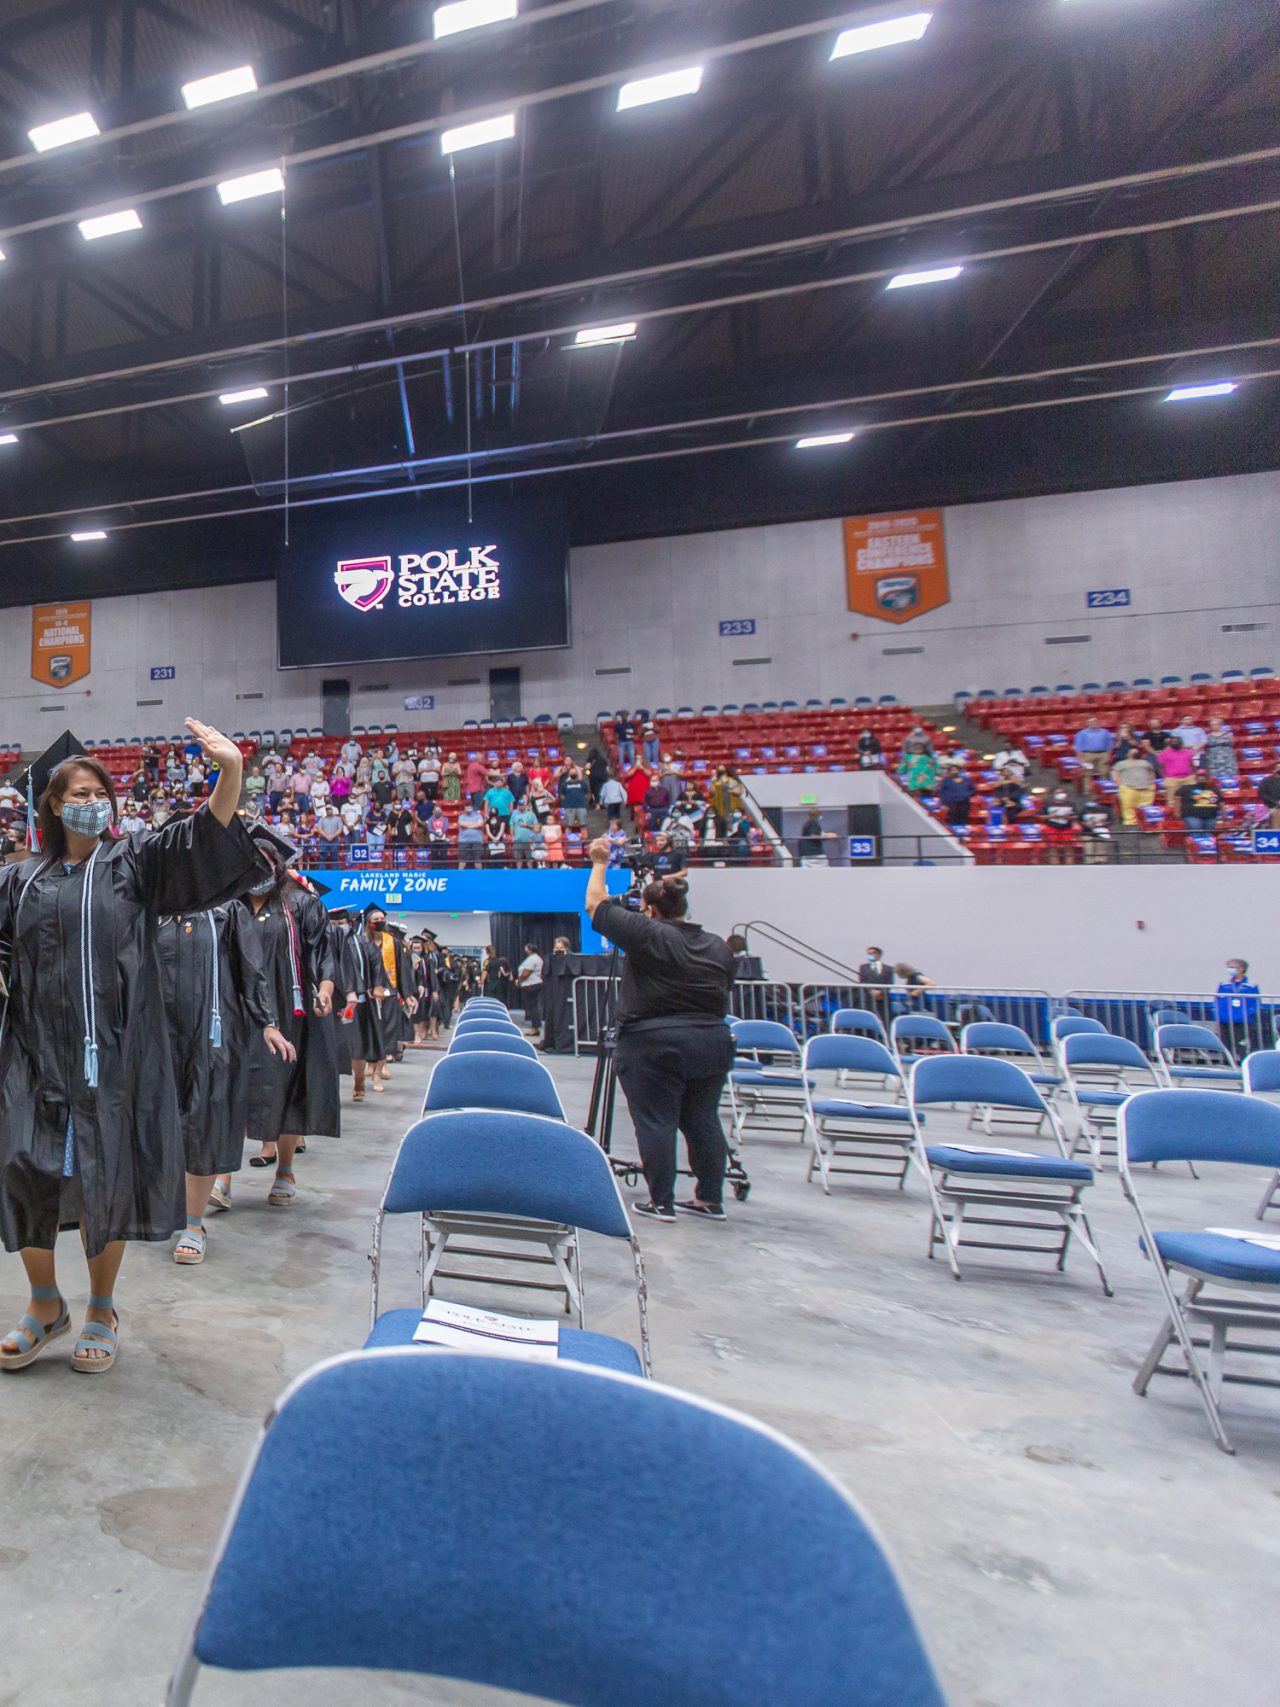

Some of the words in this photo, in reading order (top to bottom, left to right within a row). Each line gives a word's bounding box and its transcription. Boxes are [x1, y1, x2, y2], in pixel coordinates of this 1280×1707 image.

[398, 545, 500, 576] POLK
[398, 566, 500, 597] STATE
[398, 587, 501, 608] COLLEGE
[1091, 591, 1129, 606] 234
[44, 626, 80, 638] NATIONAL
[722, 621, 752, 634] 233
[39, 634, 85, 647] CHAMPIONS
[153, 668, 173, 679] 231
[852, 842, 872, 853] 33
[1256, 837, 1280, 848] 34
[354, 849, 368, 859] 32
[340, 878, 399, 892] FAMILY
[404, 877, 449, 892] ZONE
